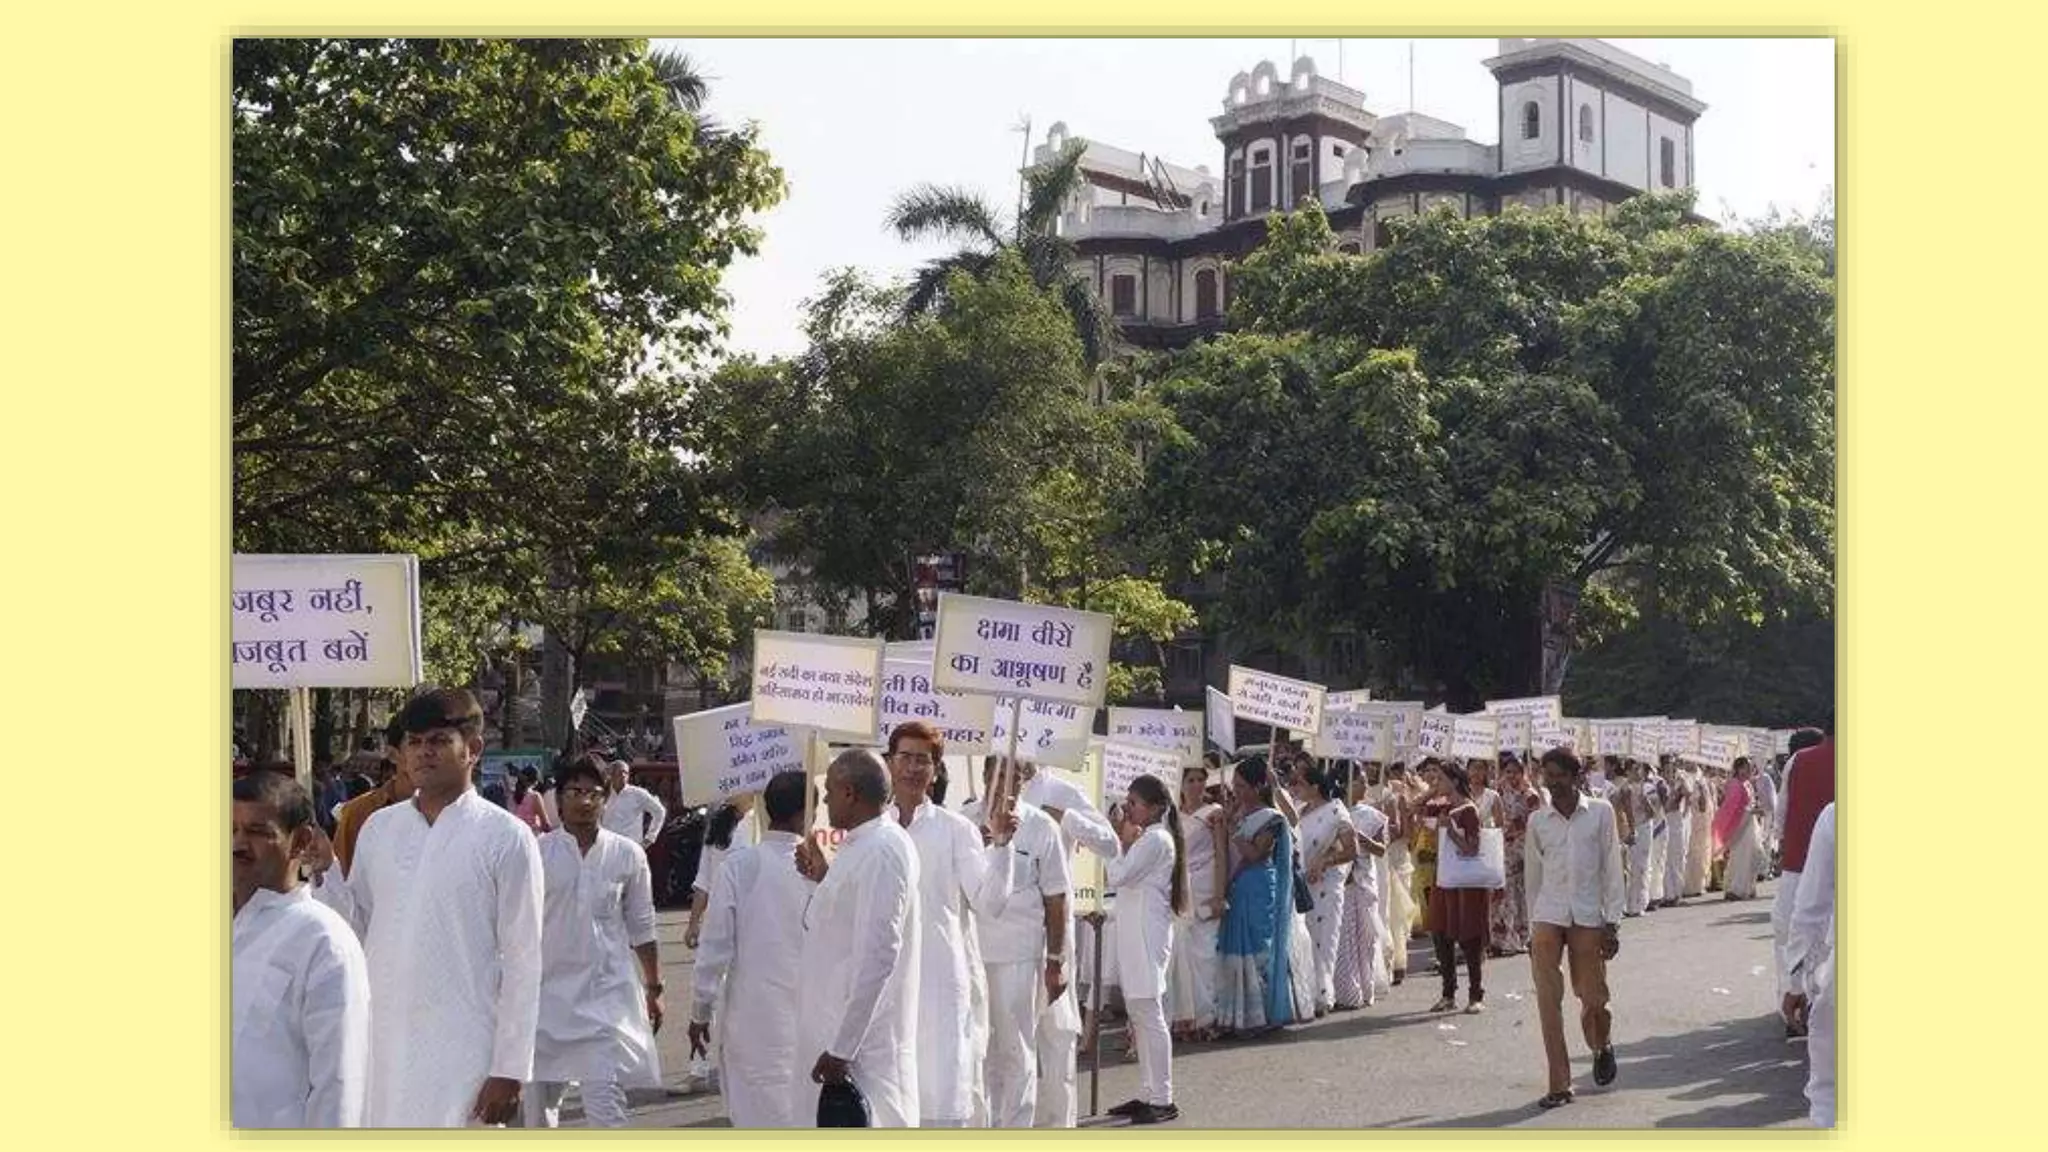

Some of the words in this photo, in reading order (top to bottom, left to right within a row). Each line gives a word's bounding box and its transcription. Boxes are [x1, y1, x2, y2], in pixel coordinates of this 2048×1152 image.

[309, 579, 373, 614] नहीं,
[323, 630, 369, 661] बनें
[977, 618, 1020, 642] क्षमा
[1032, 619, 1075, 648] वीरों
[951, 653, 979, 674] का
[991, 657, 1066, 688] आभूषण
[1077, 661, 1093, 689] है
